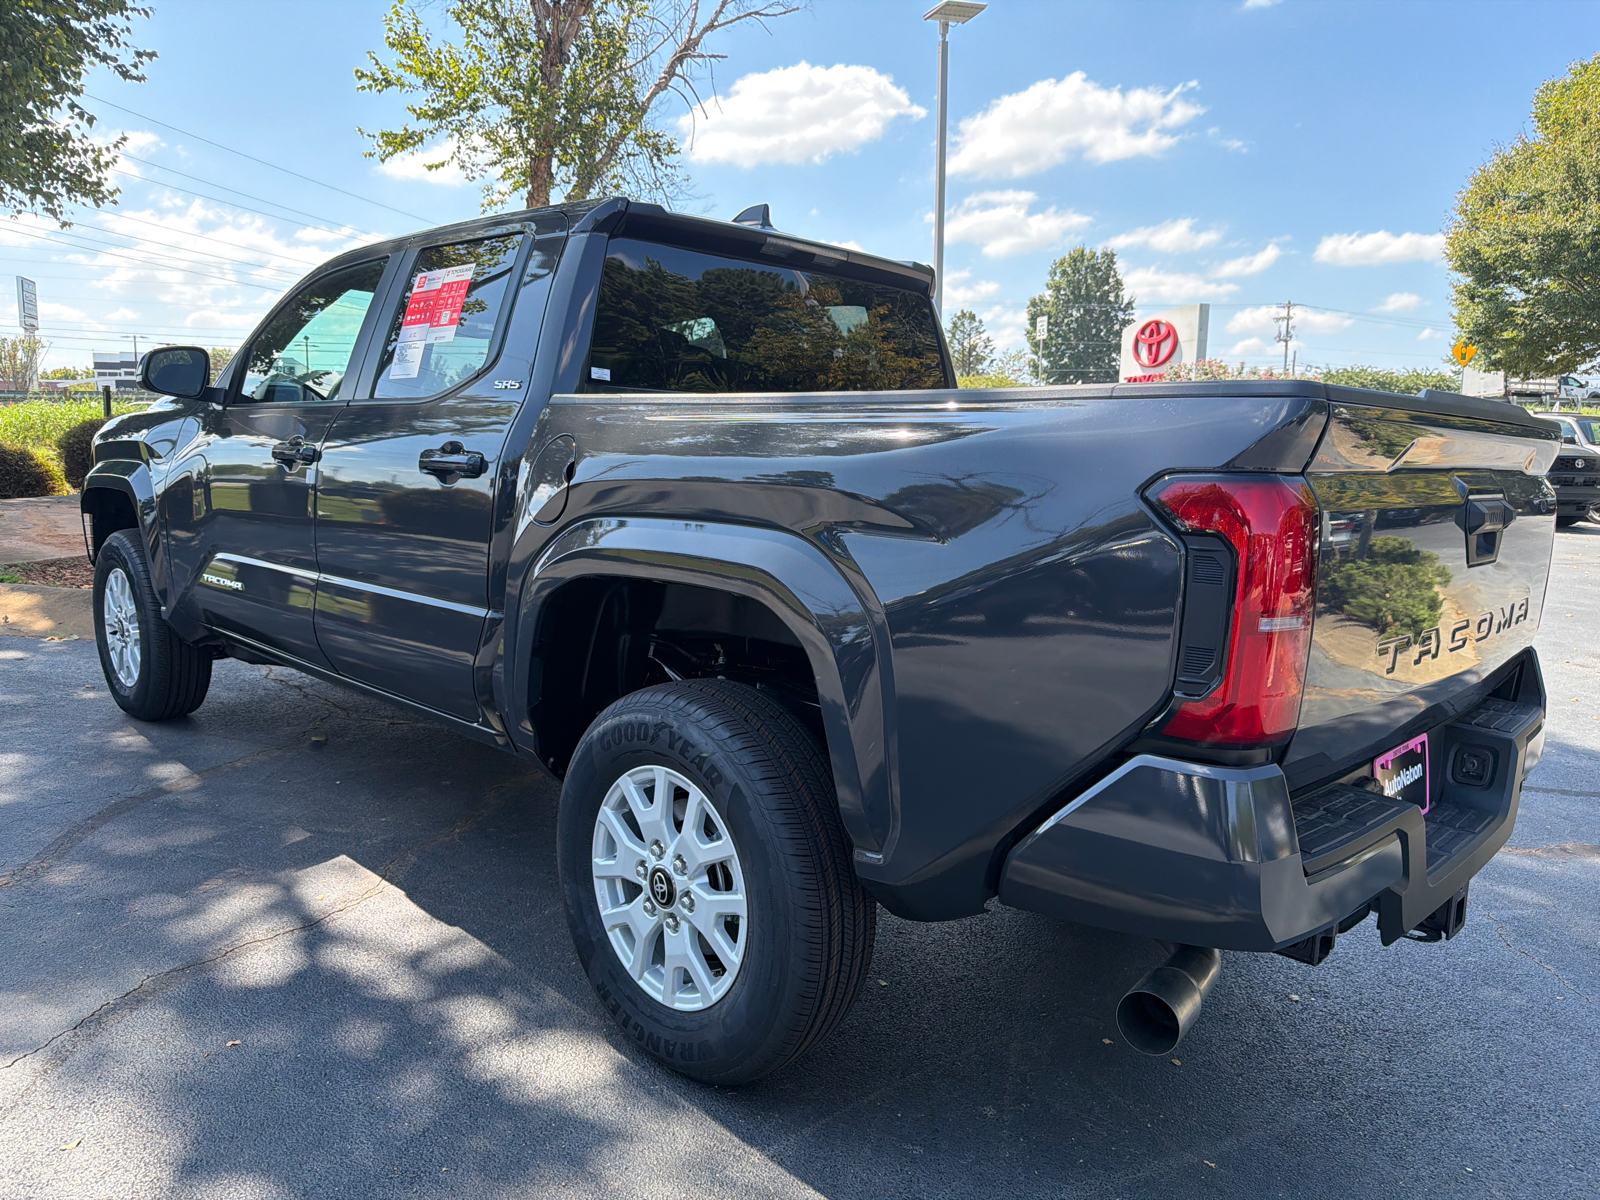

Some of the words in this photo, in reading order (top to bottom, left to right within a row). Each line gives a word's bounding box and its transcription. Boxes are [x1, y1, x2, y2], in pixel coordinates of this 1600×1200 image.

[493, 380, 521, 389] SR5
[202, 573, 243, 590] TACOMA
[1375, 597, 1529, 675] TACOMA
[1385, 763, 1423, 796] AutoNation
[596, 980, 718, 1062] WRANGLER
